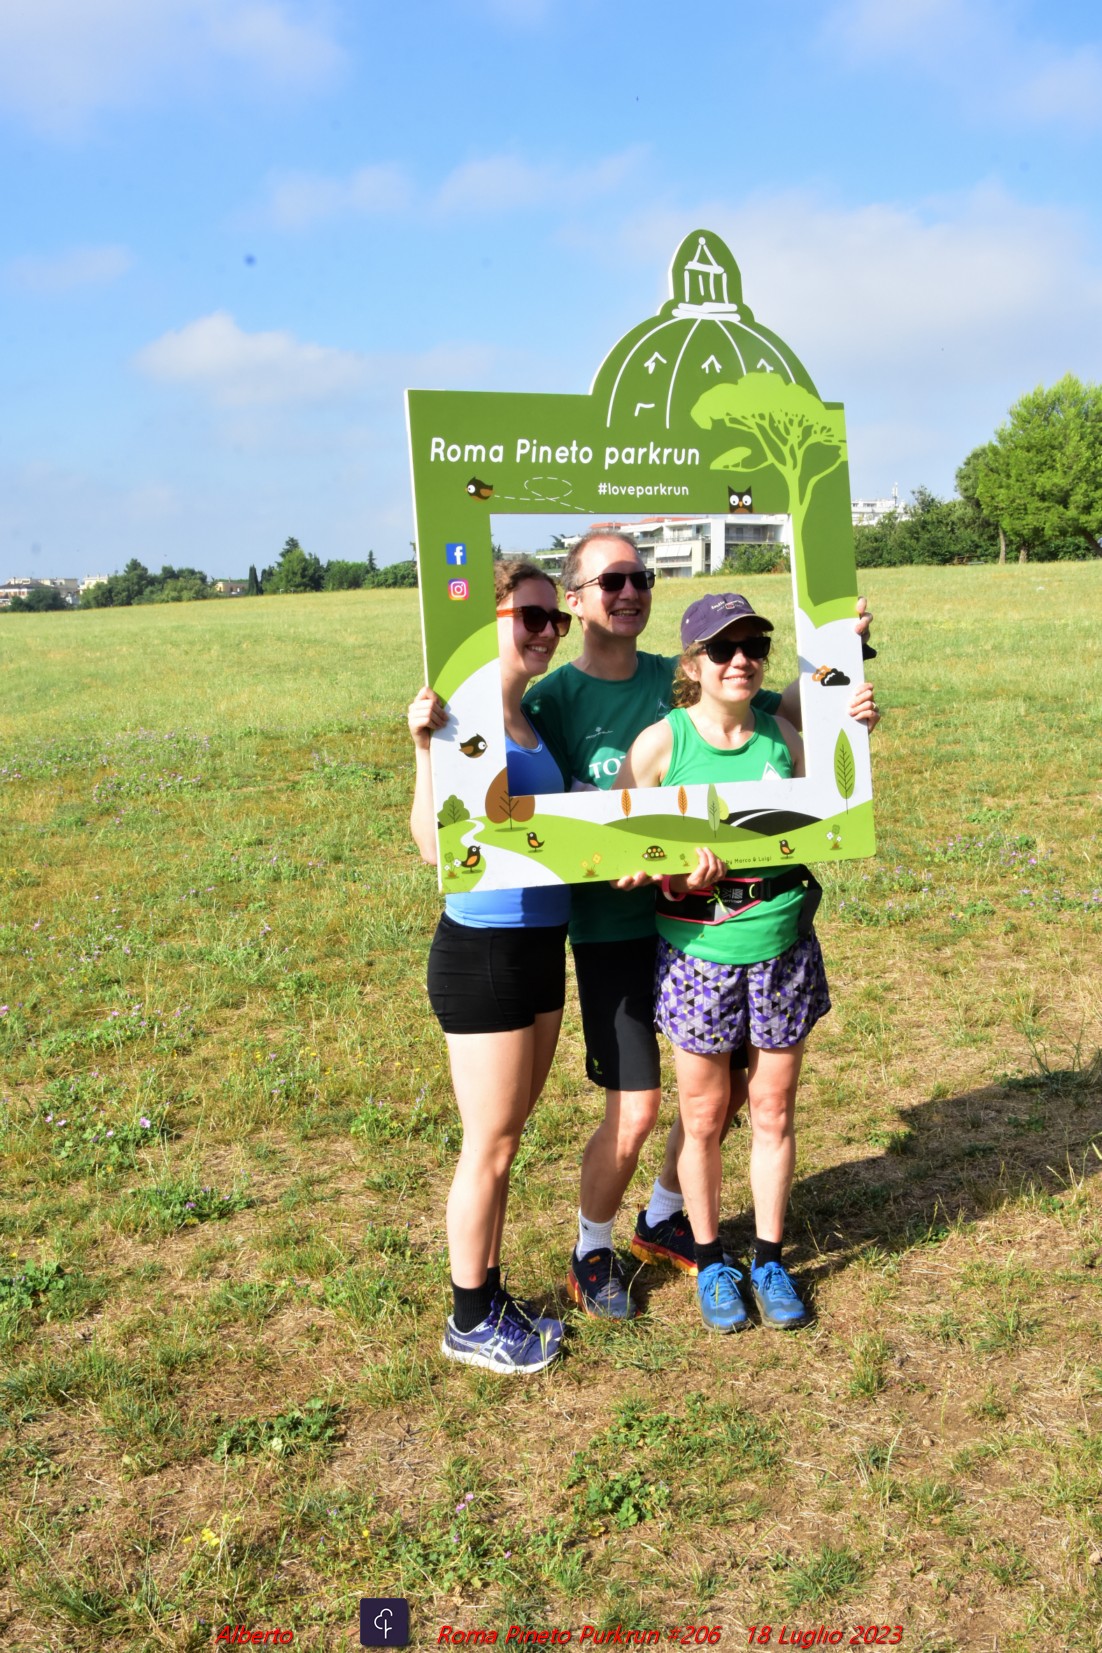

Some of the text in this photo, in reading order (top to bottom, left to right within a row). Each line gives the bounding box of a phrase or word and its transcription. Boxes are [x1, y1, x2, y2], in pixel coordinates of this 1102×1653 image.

[430, 436, 700, 470] Roma Pineto parkrun
[597, 482, 689, 498] #loveparkrun
[589, 755, 626, 779] TO
